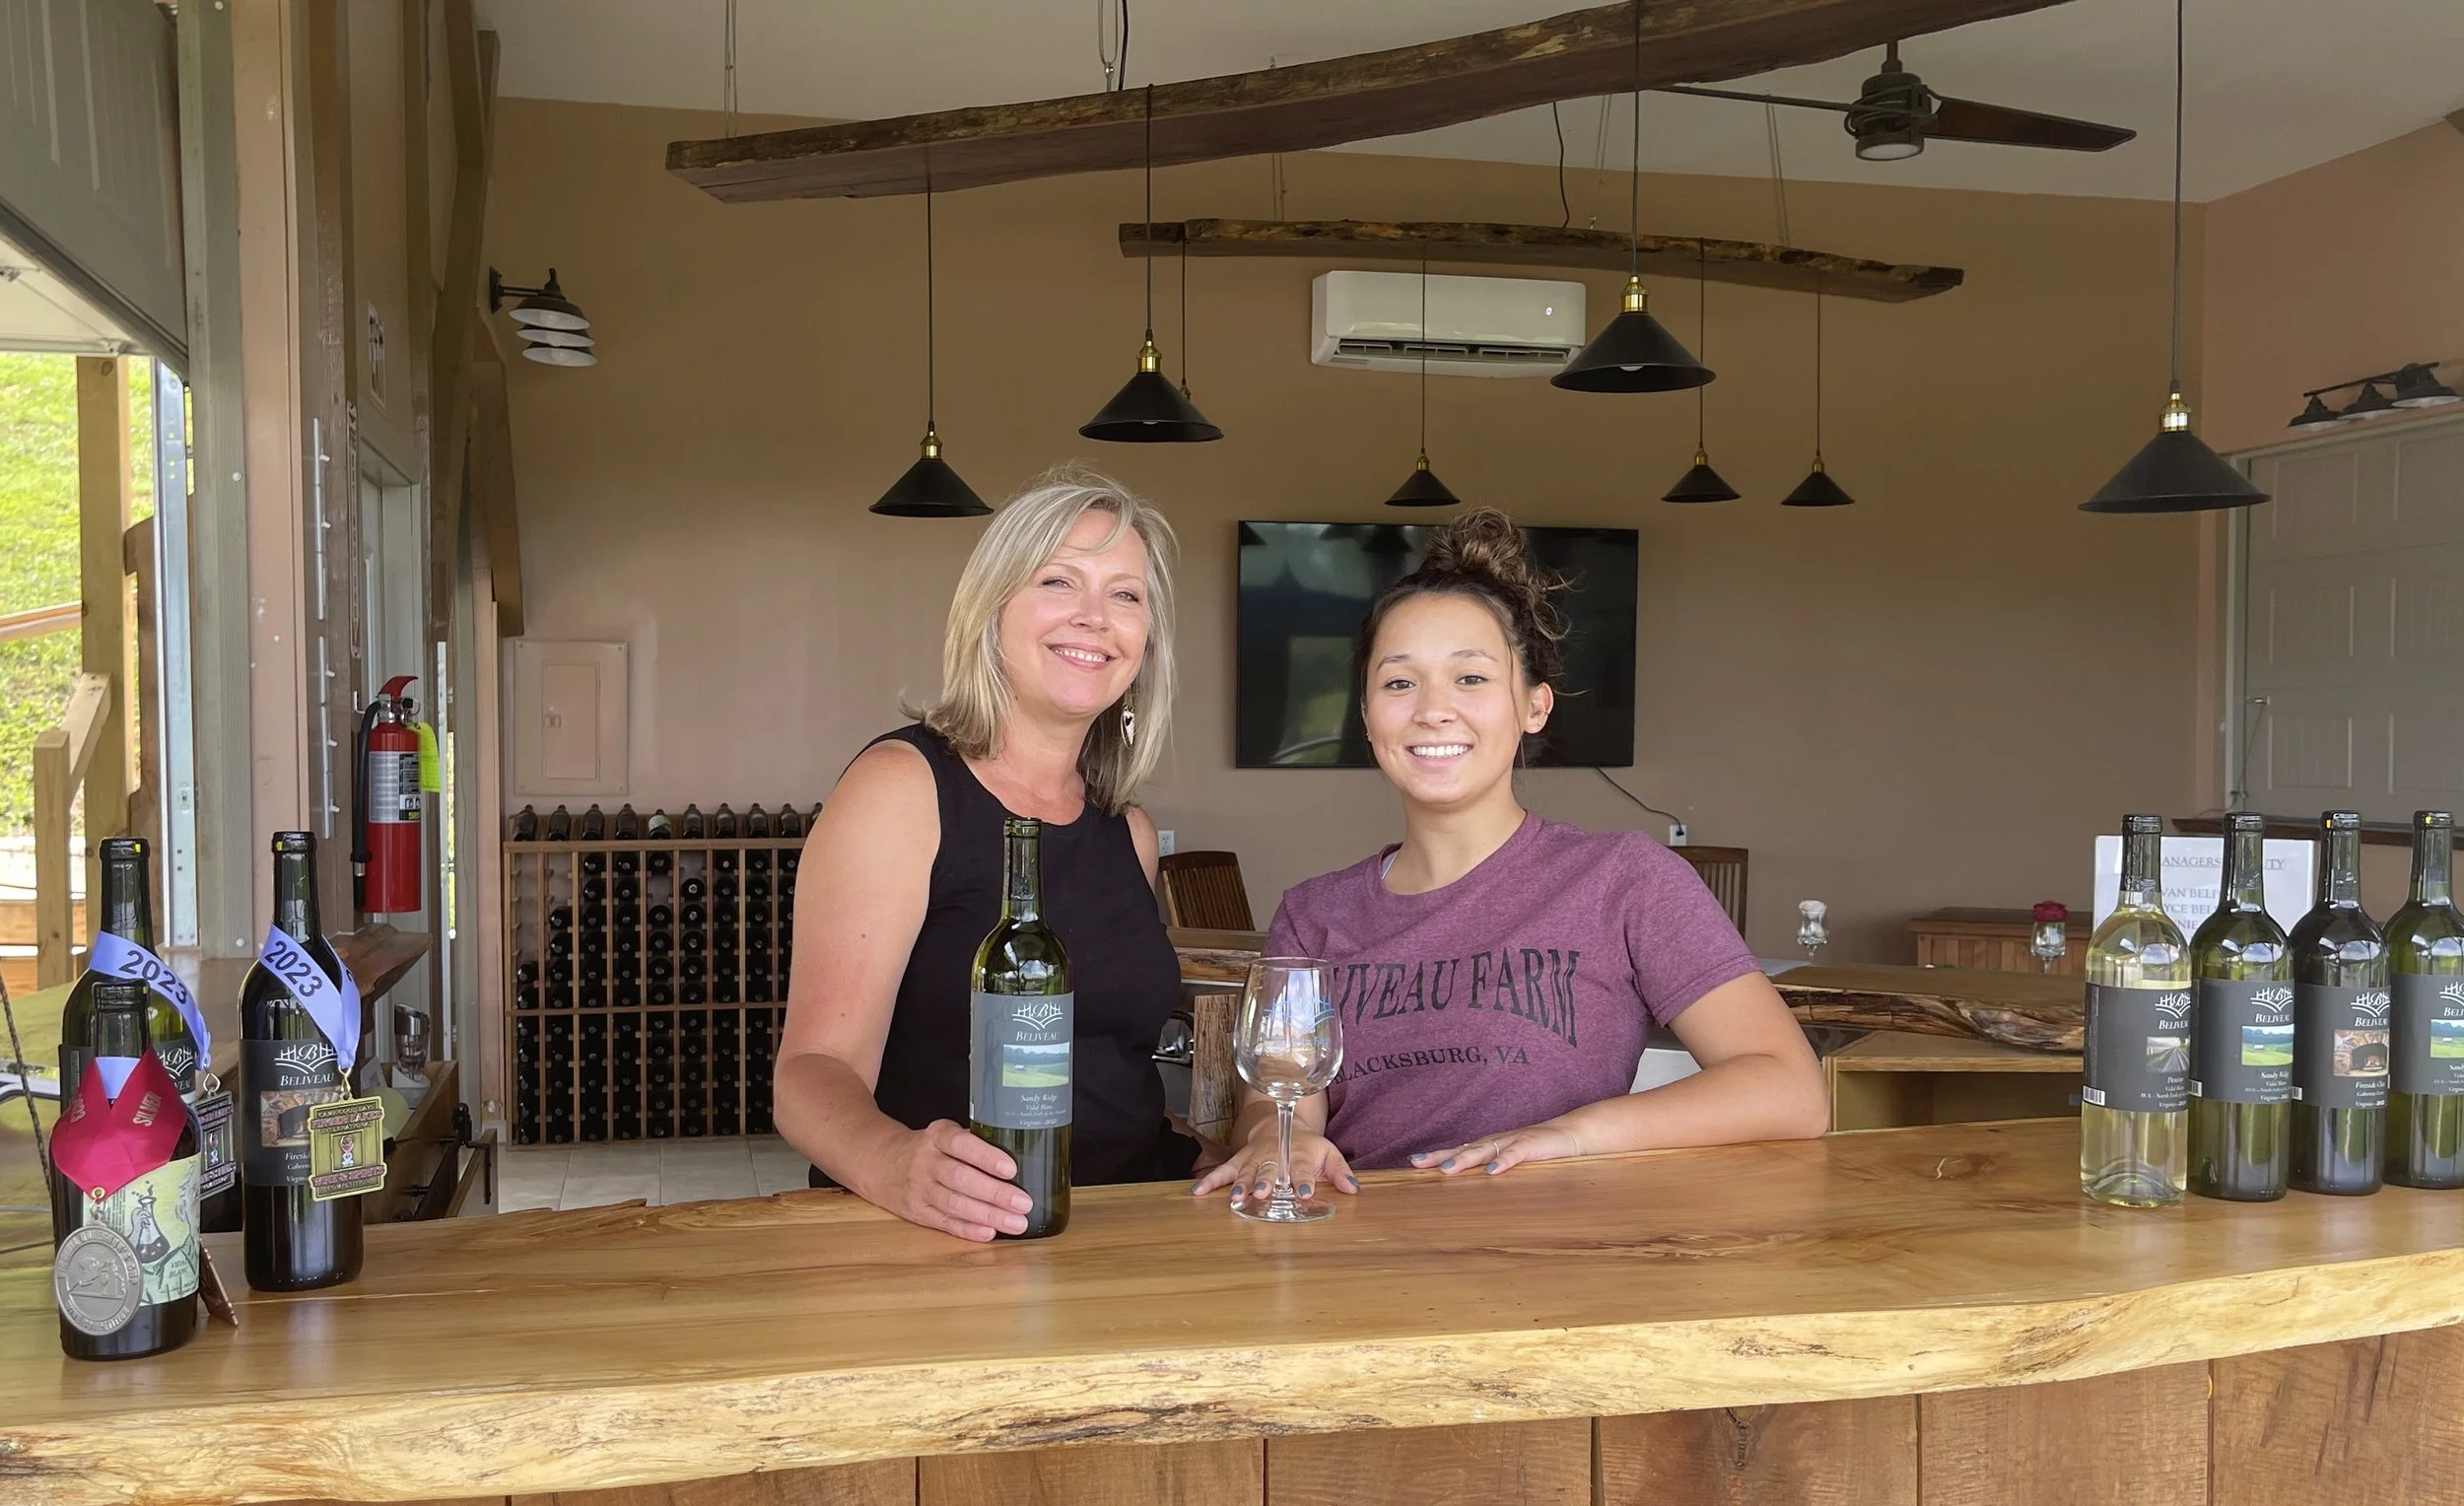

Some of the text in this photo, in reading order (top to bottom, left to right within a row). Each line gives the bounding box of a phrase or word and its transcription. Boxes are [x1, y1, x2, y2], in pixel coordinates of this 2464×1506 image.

[2161, 856, 2221, 867] ANAGERS
[2162, 889, 2184, 899] VAN
[2165, 904, 2187, 914] YCE
[264, 941, 323, 996] 2023
[118, 950, 187, 1004] 2023
[1335, 947, 1579, 1048] IVEAU FARM
[1496, 1046, 1530, 1064] VA
[281, 1072, 335, 1087] BELIVEAU
[320, 1122, 373, 1134] INTERNATIONAL
